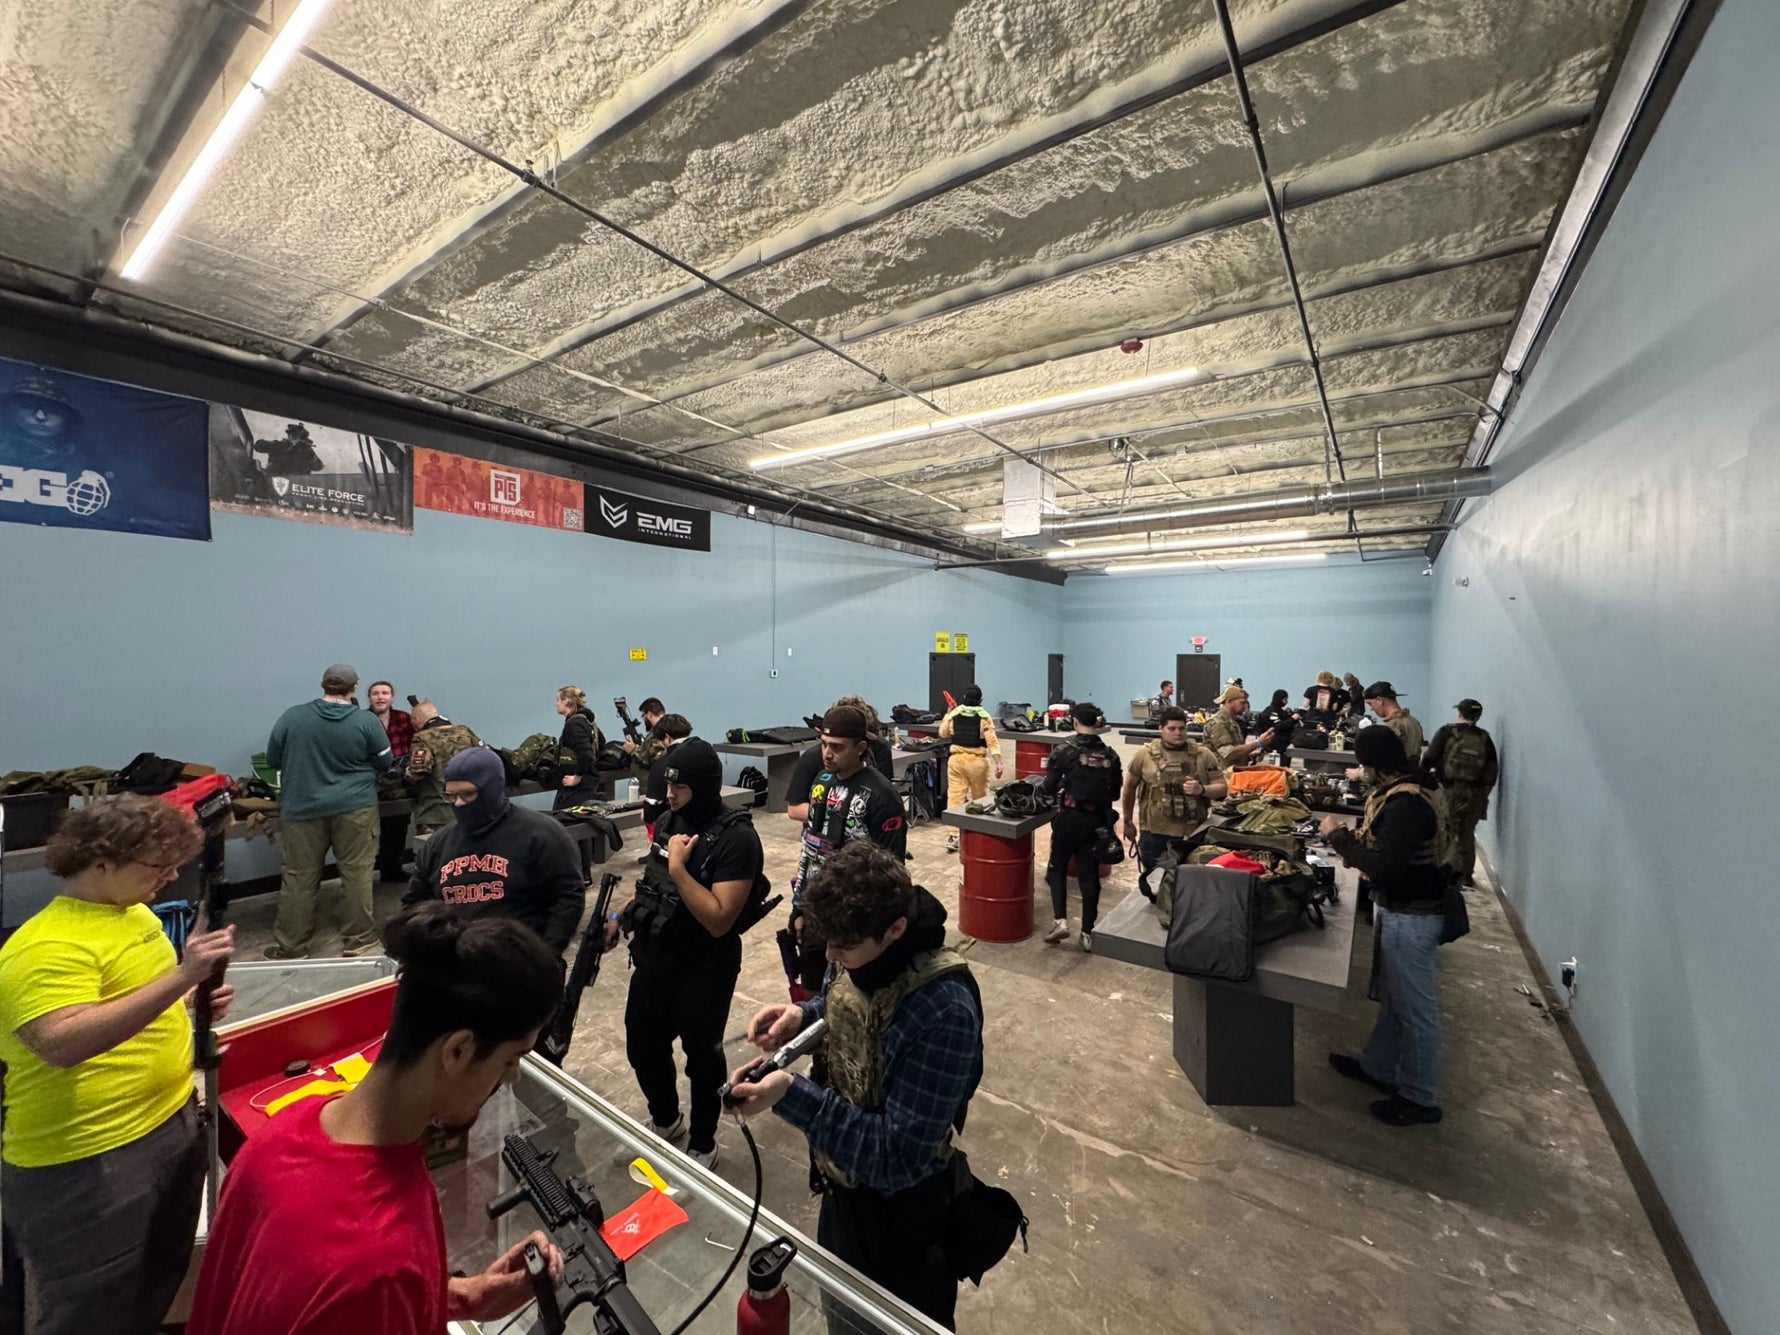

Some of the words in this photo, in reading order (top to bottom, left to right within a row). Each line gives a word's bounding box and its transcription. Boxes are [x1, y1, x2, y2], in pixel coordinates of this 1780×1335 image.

[292, 483, 325, 497] ELITE
[328, 489, 365, 503] FORCE
[494, 474, 518, 502] PTS
[473, 501, 487, 511] IT'S
[487, 503, 499, 512] THE
[500, 505, 536, 519] EXPERIENCE
[635, 511, 693, 535] EMG
[637, 527, 693, 540] INTERNATIONAL
[442, 880, 505, 904] CROCS
